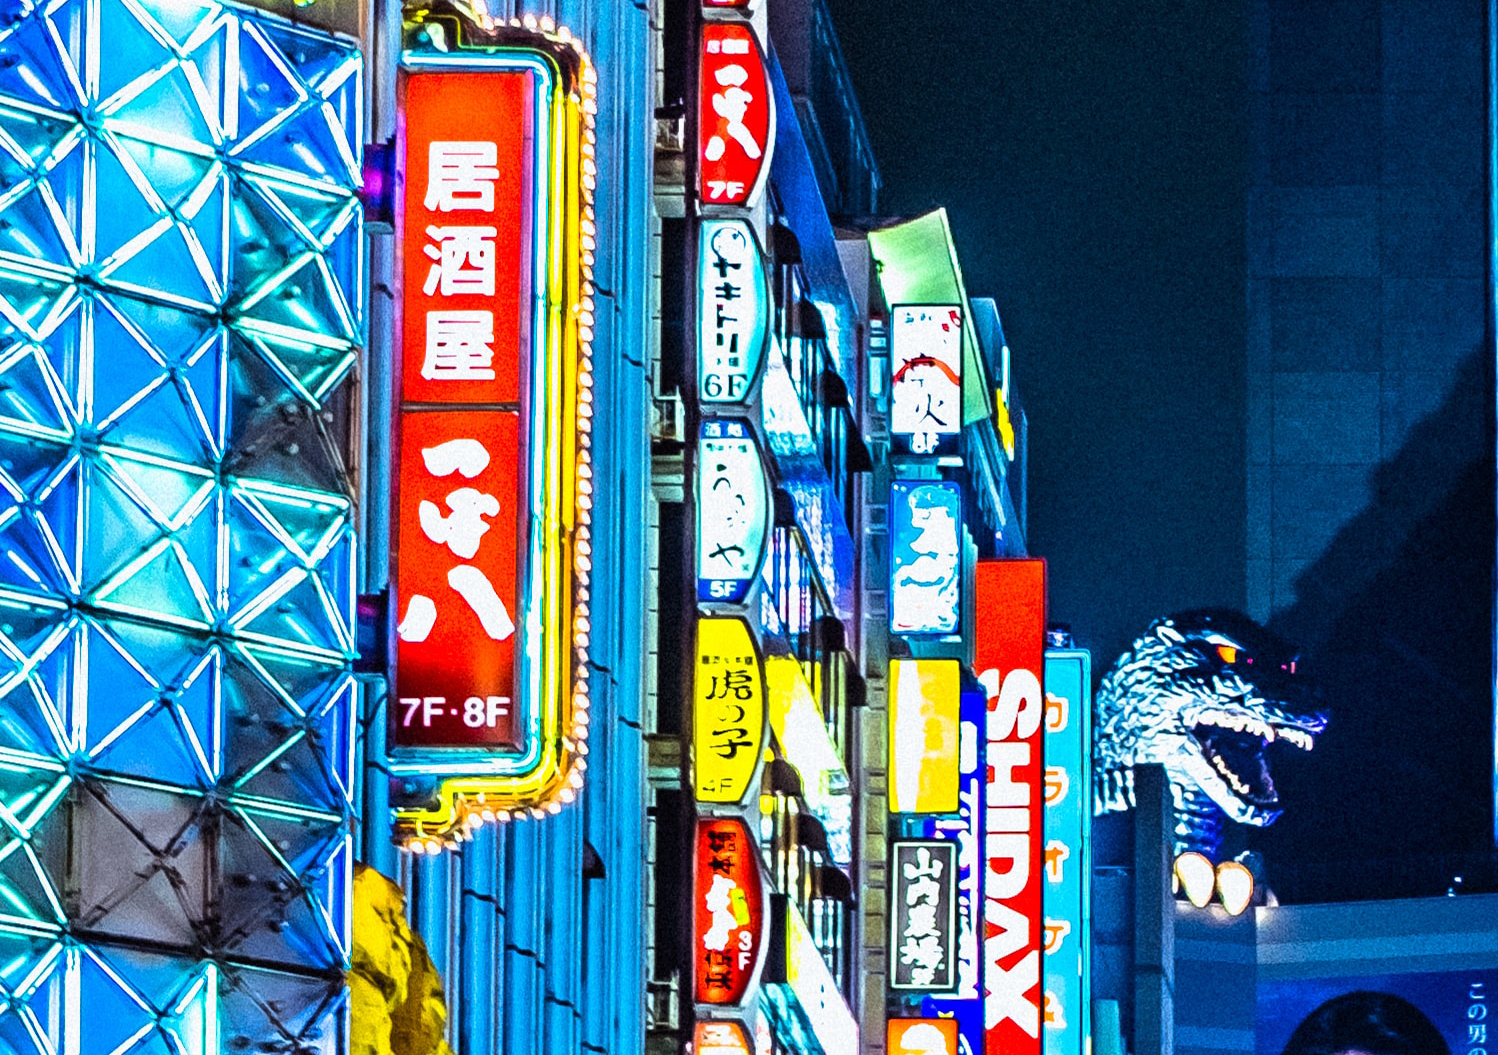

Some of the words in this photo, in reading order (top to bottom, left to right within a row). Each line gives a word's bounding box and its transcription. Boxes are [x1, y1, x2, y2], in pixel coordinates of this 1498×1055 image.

[707, 181, 744, 199] 7F
[423, 140, 499, 380] 居酒屋
[705, 374, 748, 397] 6F
[710, 581, 737, 597] 5F
[710, 669, 753, 759] 虎の子
[978, 669, 1041, 1039] SHIDAX
